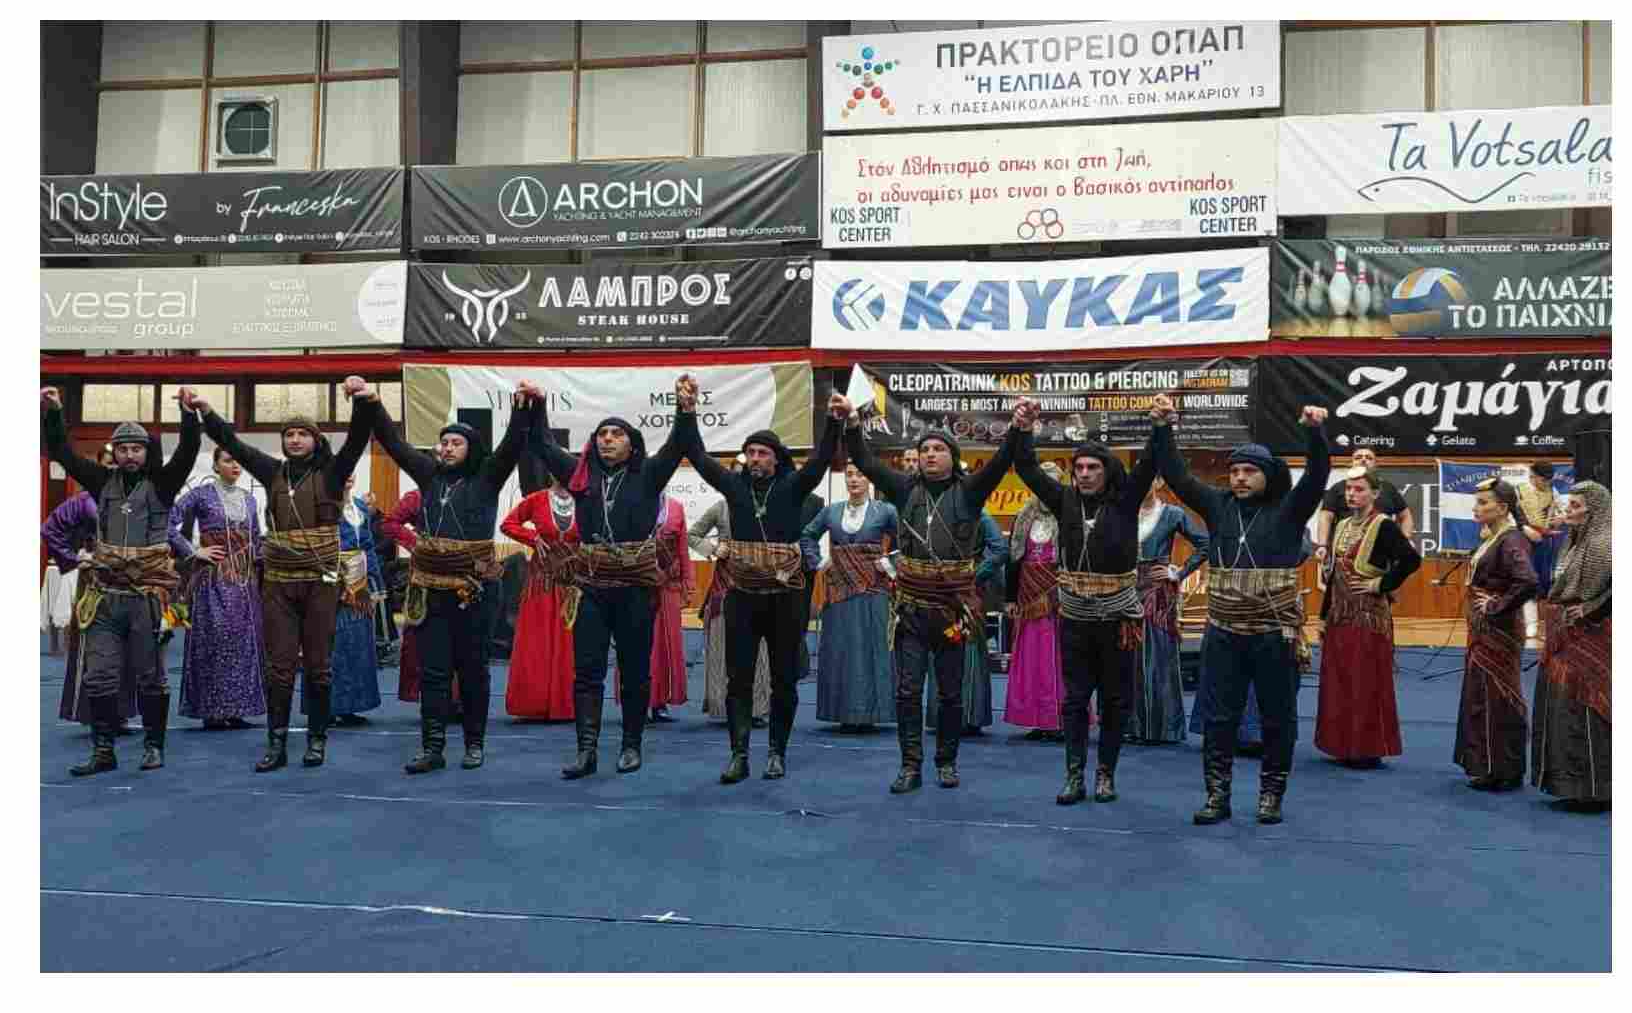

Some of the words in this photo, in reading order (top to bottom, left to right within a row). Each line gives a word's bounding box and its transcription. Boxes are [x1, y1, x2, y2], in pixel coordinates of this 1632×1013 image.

[936, 33, 1139, 68] ΠΡΑΚΤΟΡΕΙΟ
[1151, 25, 1245, 56] ΟΠΑΠ
[1000, 71, 1082, 93] ΕΛΠΙΔΑ
[1089, 67, 1132, 88] ΤΟΥ
[1165, 87, 1241, 102] ΜΑΚΑΡΙΟΥ
[1250, 85, 1265, 98] 13
[1382, 122, 1427, 171] Ta
[1449, 117, 1612, 169] Votsala
[1044, 156, 1070, 171] και
[1077, 155, 1107, 170] στη
[552, 177, 703, 210] ARCHON
[970, 185, 999, 205] μας
[49, 181, 168, 229] InStyle
[216, 202, 232, 215] by
[639, 207, 702, 219] MANAGEMENT
[1189, 197, 1218, 215] KOS
[1222, 195, 1268, 213] SPORT
[831, 207, 856, 225] KOS
[858, 207, 901, 224] SPORT
[838, 226, 891, 242] CENTER
[1199, 217, 1257, 234] CENTER
[74, 234, 101, 246] HAIR
[102, 234, 141, 246] SALON
[44, 276, 199, 319] vestal
[537, 273, 731, 307] ΛΑΜΠΡΟΣ
[899, 266, 1244, 331] ΚΑΥΚΑΣ
[578, 314, 630, 326] STEAK
[637, 313, 690, 325] HOUSE
[1447, 305, 1487, 329] ΤΟ
[1495, 303, 1612, 328] ΠΑΙΧΝΙ
[134, 321, 195, 339] group
[889, 372, 996, 393] CLEOPATRAINK
[999, 371, 1032, 391] KOS
[1034, 371, 1091, 391] TATTOO
[1094, 371, 1105, 390] &
[1108, 369, 1179, 390] PIERCING
[649, 390, 713, 406] ΜΕΣ
[914, 397, 960, 412] LARGEST
[971, 396, 999, 412] MOST
[1088, 395, 1128, 410] TATTOO
[1183, 394, 1249, 409] WORLDWIDE
[1335, 362, 1612, 432] Ζαμάγια
[1353, 435, 1395, 447] Catering
[1442, 435, 1476, 446] Gelato
[1531, 435, 1565, 446] Coffee
